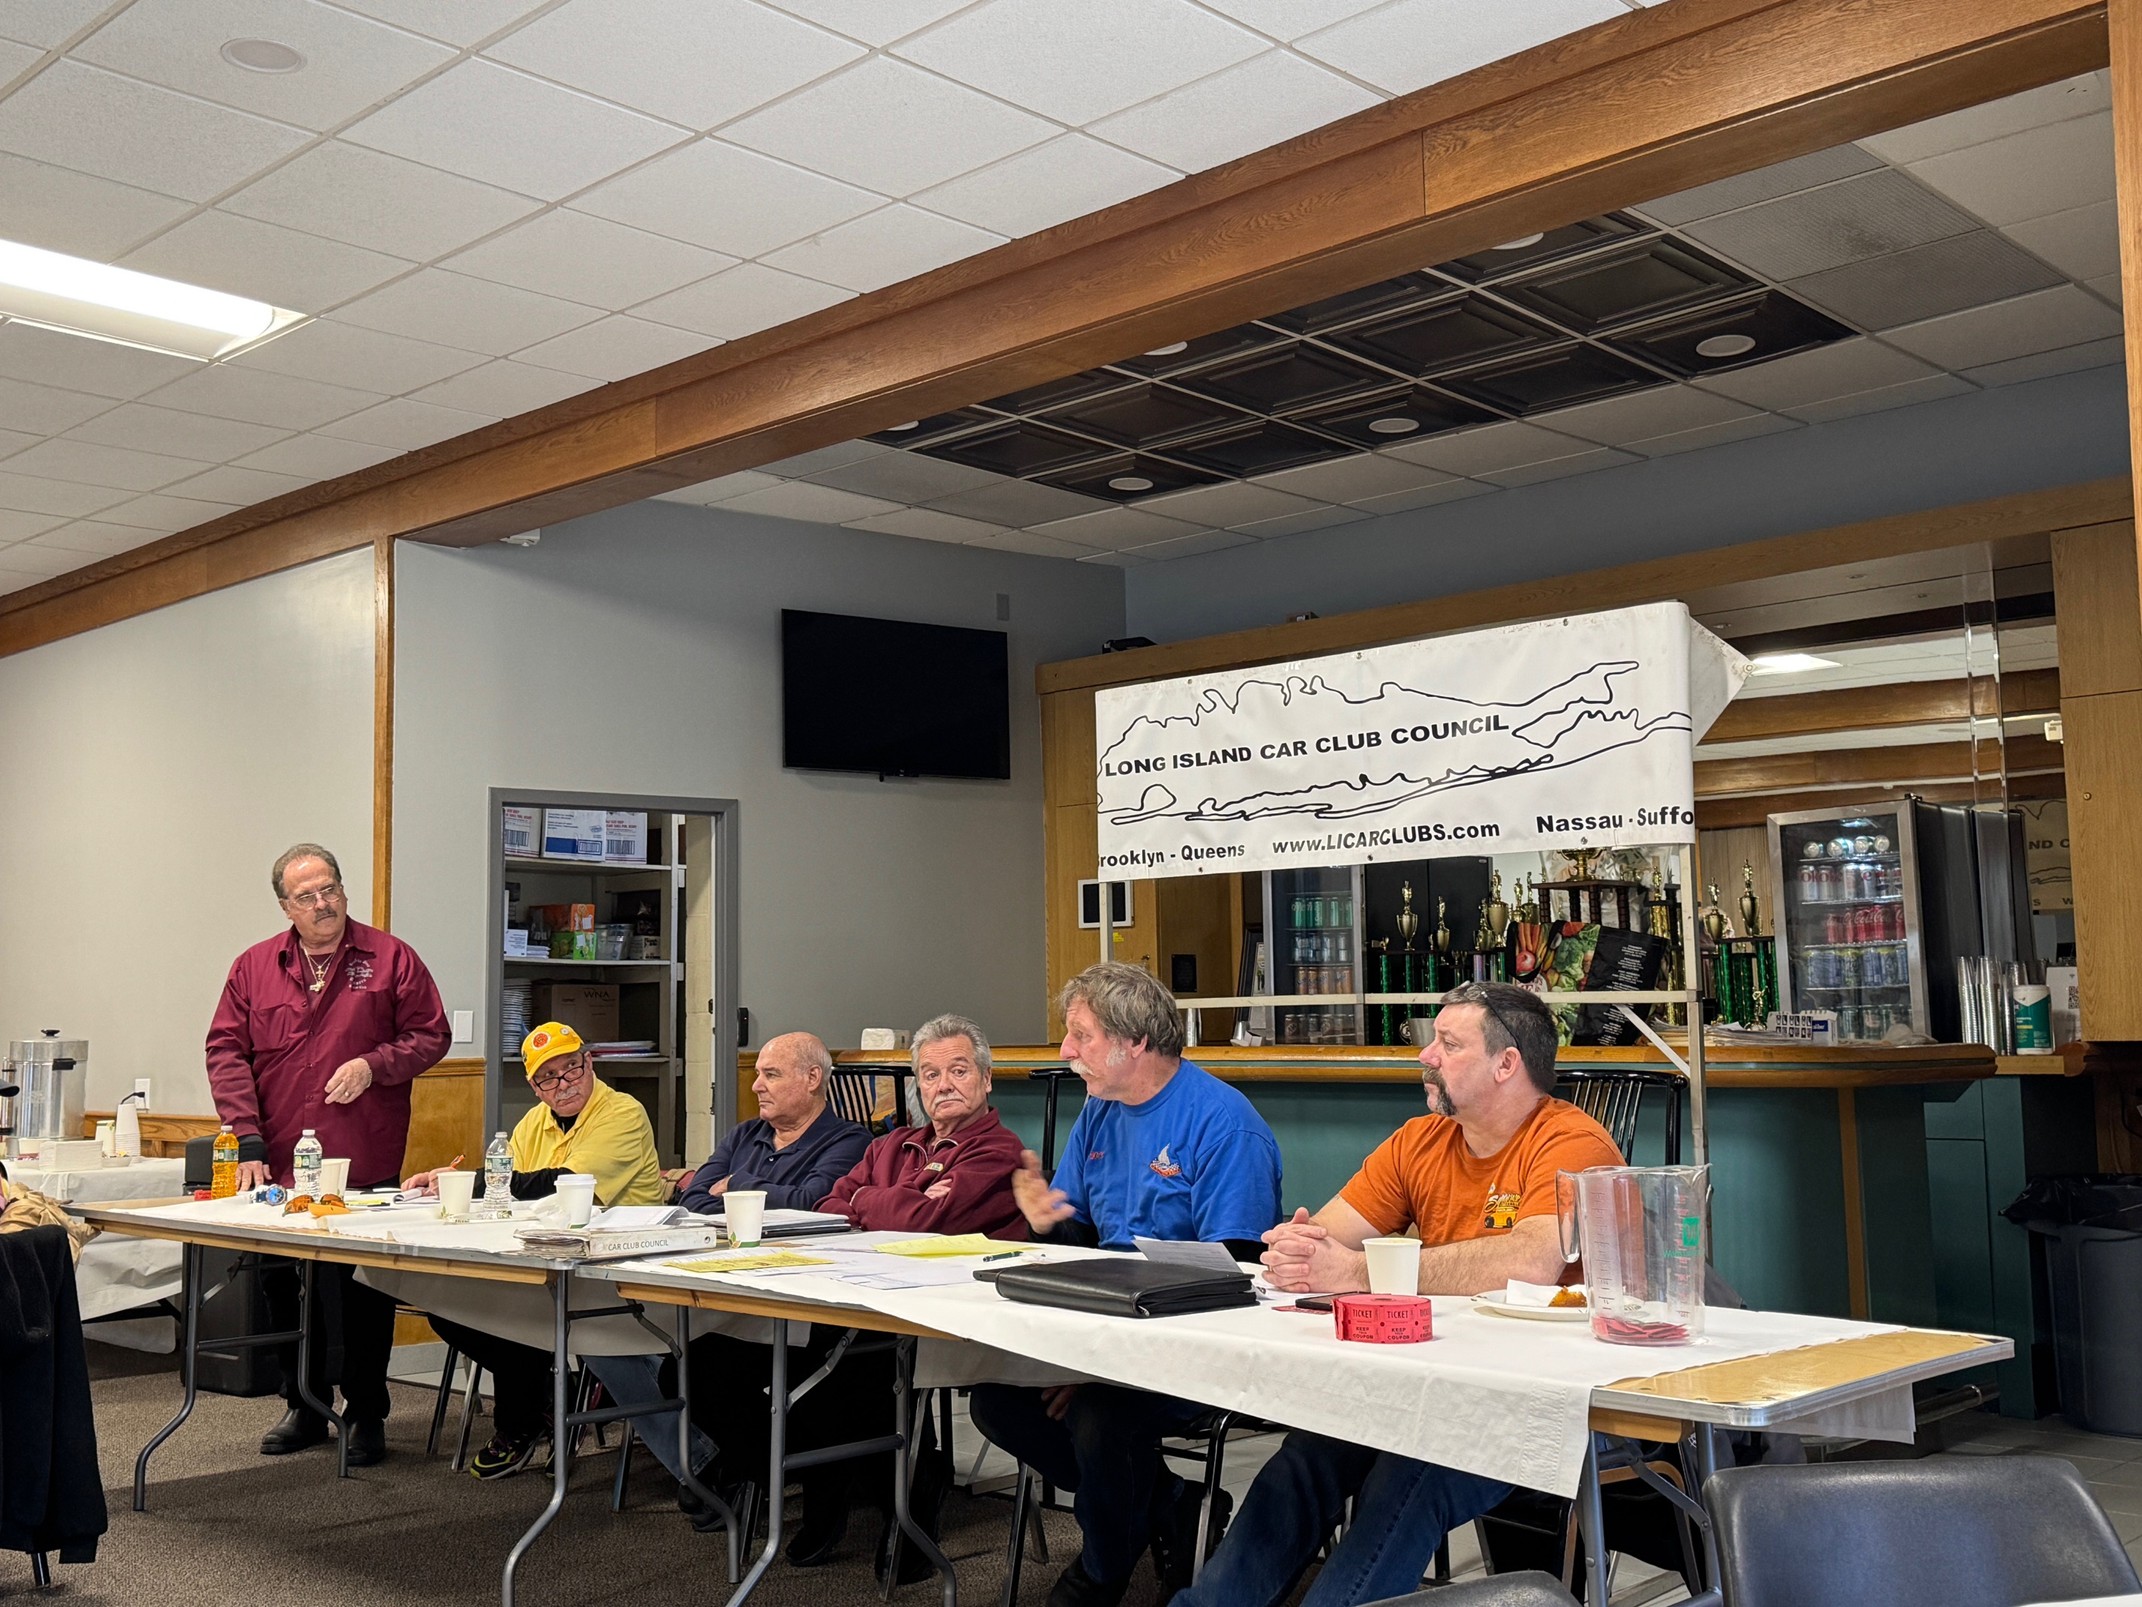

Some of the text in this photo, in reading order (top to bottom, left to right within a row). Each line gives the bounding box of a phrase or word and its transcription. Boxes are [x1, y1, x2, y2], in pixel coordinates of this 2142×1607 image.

[1105, 714, 1509, 777] LONG ISLAND CAR CLUB COUNCIL
[1536, 815, 1623, 833] Nassau
[1637, 806, 1694, 827] Suffo
[1272, 823, 1500, 853] www.LICARCLUBS.com
[1100, 850, 1165, 867] rooklyn
[1181, 844, 1246, 861] Queens
[608, 1243, 622, 1251] CAR
[622, 1241, 639, 1250] CLUB
[640, 1240, 669, 1248] COUNCIL
[1352, 1309, 1372, 1319] TICKET
[1387, 1310, 1408, 1319] TICKET
